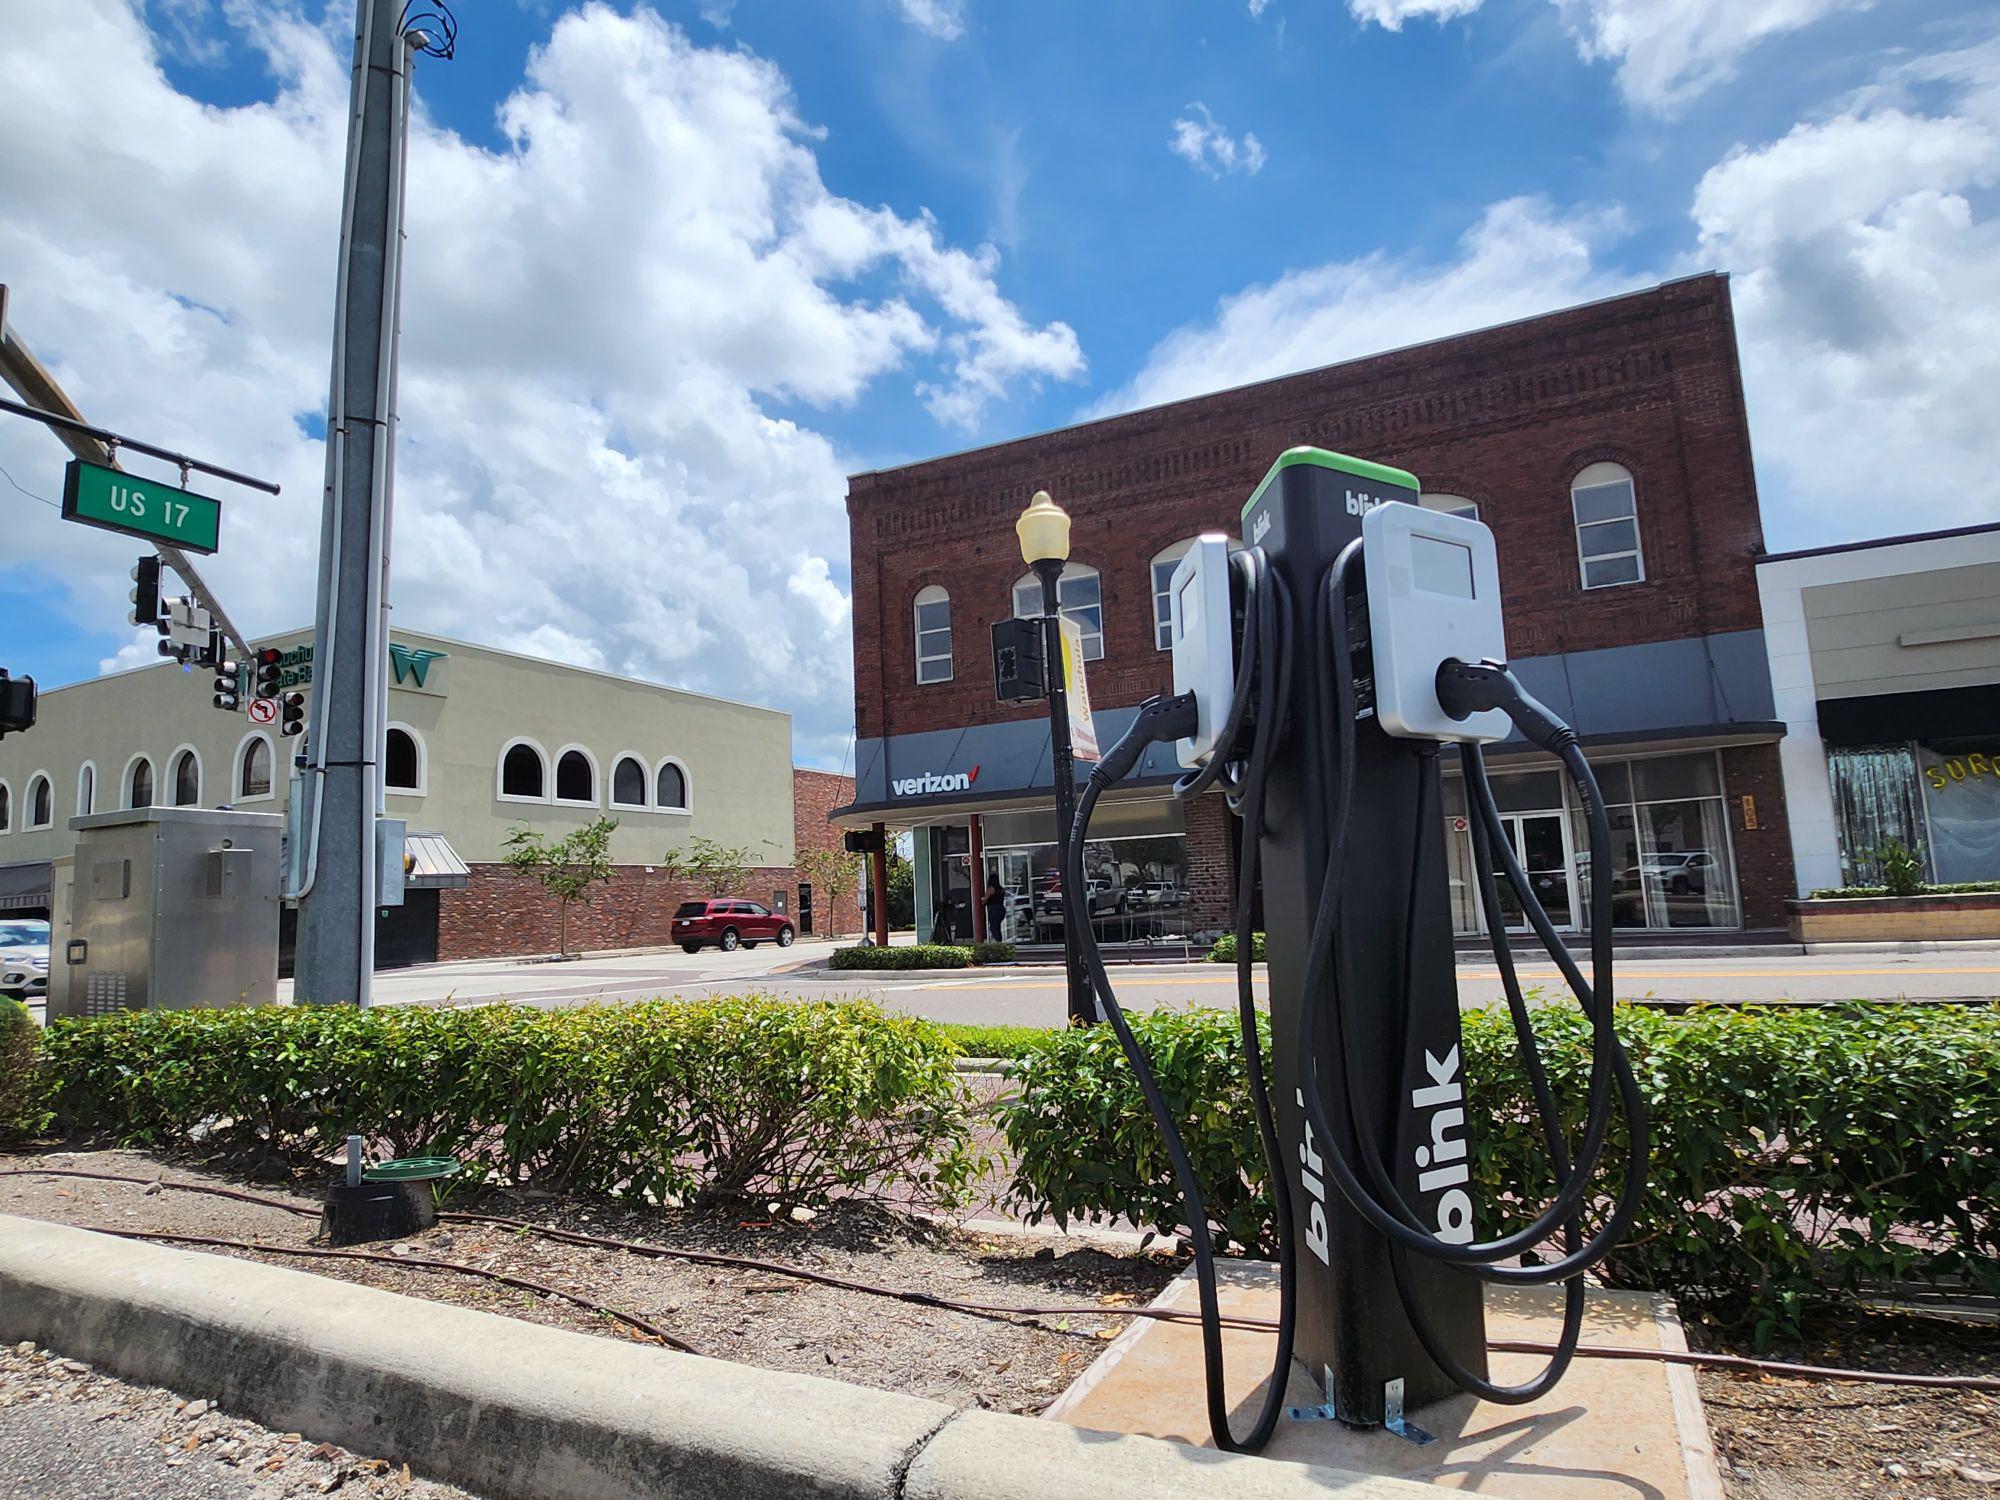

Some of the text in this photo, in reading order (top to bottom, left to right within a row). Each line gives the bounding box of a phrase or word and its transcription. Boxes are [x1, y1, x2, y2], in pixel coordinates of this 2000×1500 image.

[110, 485, 190, 528] US 17
[892, 771, 970, 796] verizon
[1412, 1043, 1474, 1245] blink
